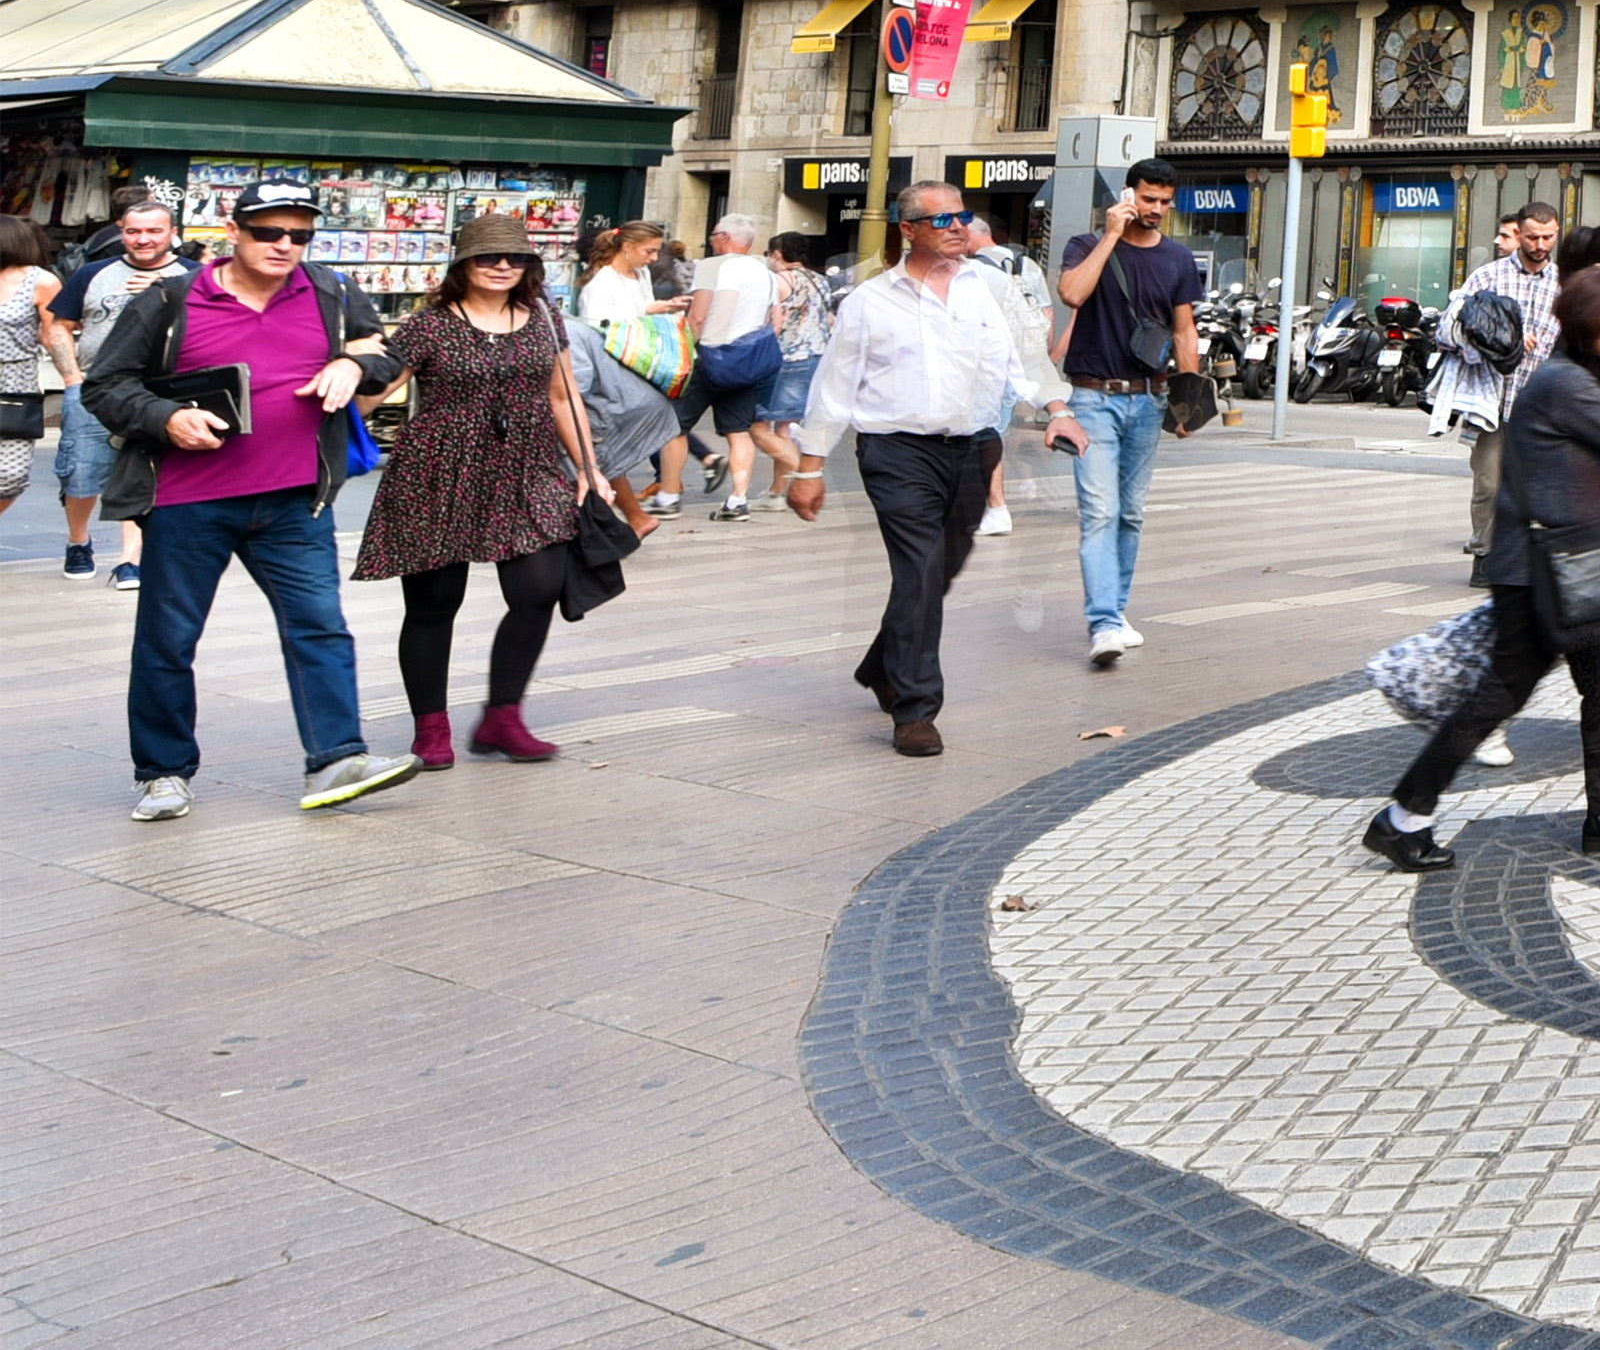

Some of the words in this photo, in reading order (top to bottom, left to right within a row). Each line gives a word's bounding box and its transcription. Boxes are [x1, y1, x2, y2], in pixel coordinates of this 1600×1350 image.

[820, 162, 861, 190] pans
[984, 159, 1029, 188] pans
[1194, 190, 1236, 210] BBVA
[1395, 187, 1441, 208] BBVA
